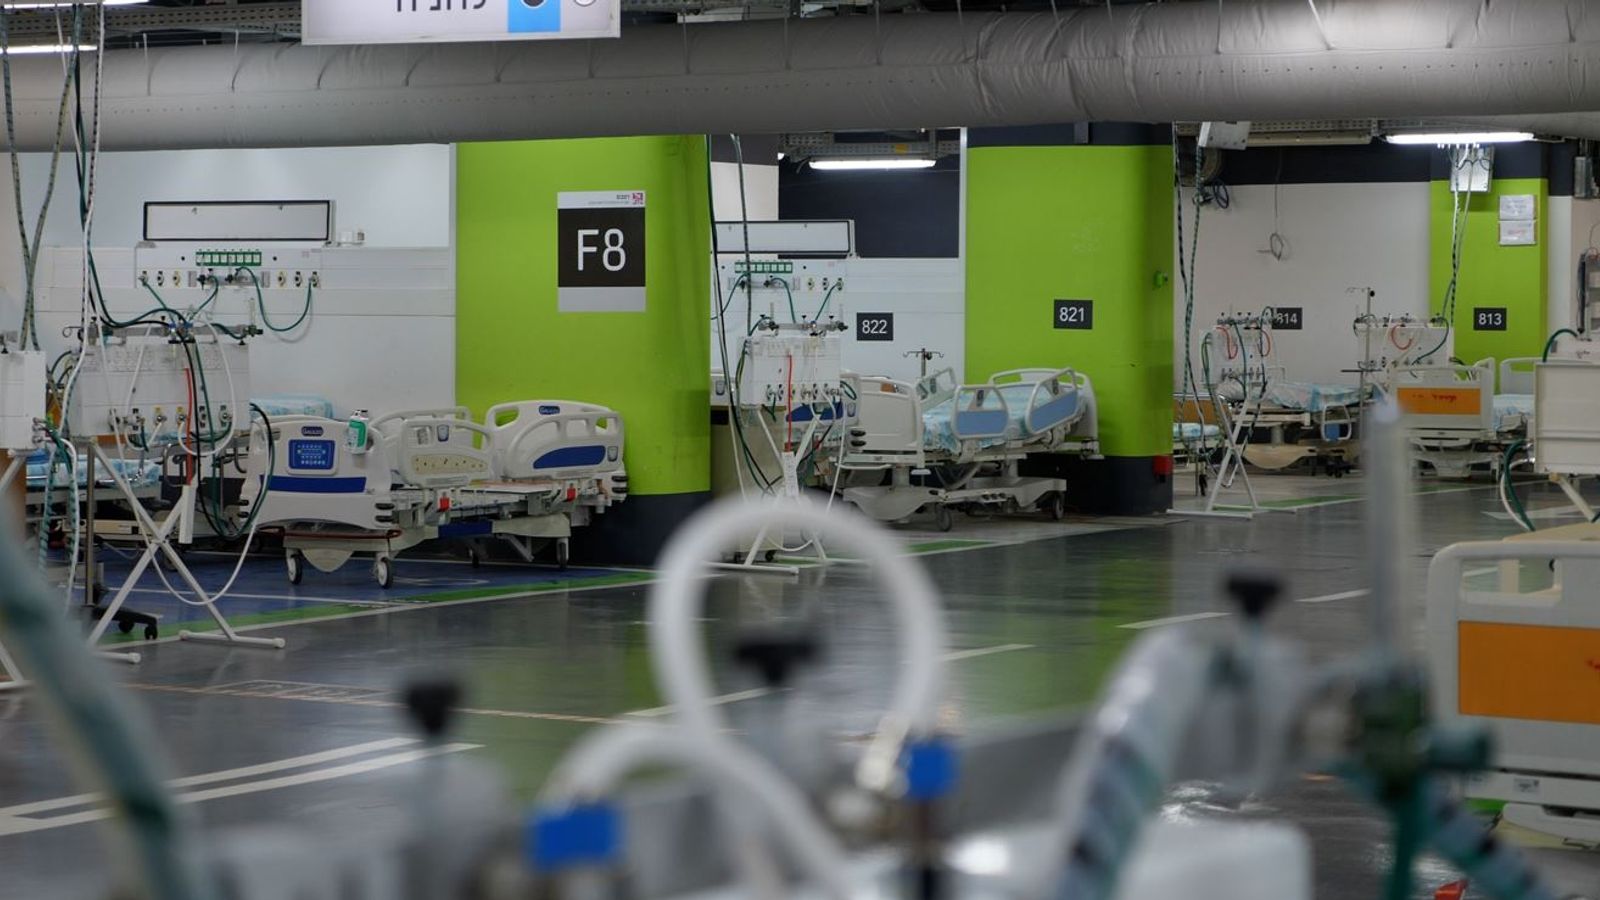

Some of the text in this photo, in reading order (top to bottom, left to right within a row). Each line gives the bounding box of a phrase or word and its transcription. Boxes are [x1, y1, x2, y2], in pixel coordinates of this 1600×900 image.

[577, 228, 626, 272] F8
[1060, 306, 1085, 322] 821
[1479, 312, 1502, 325] 813
[862, 319, 887, 334] 822
